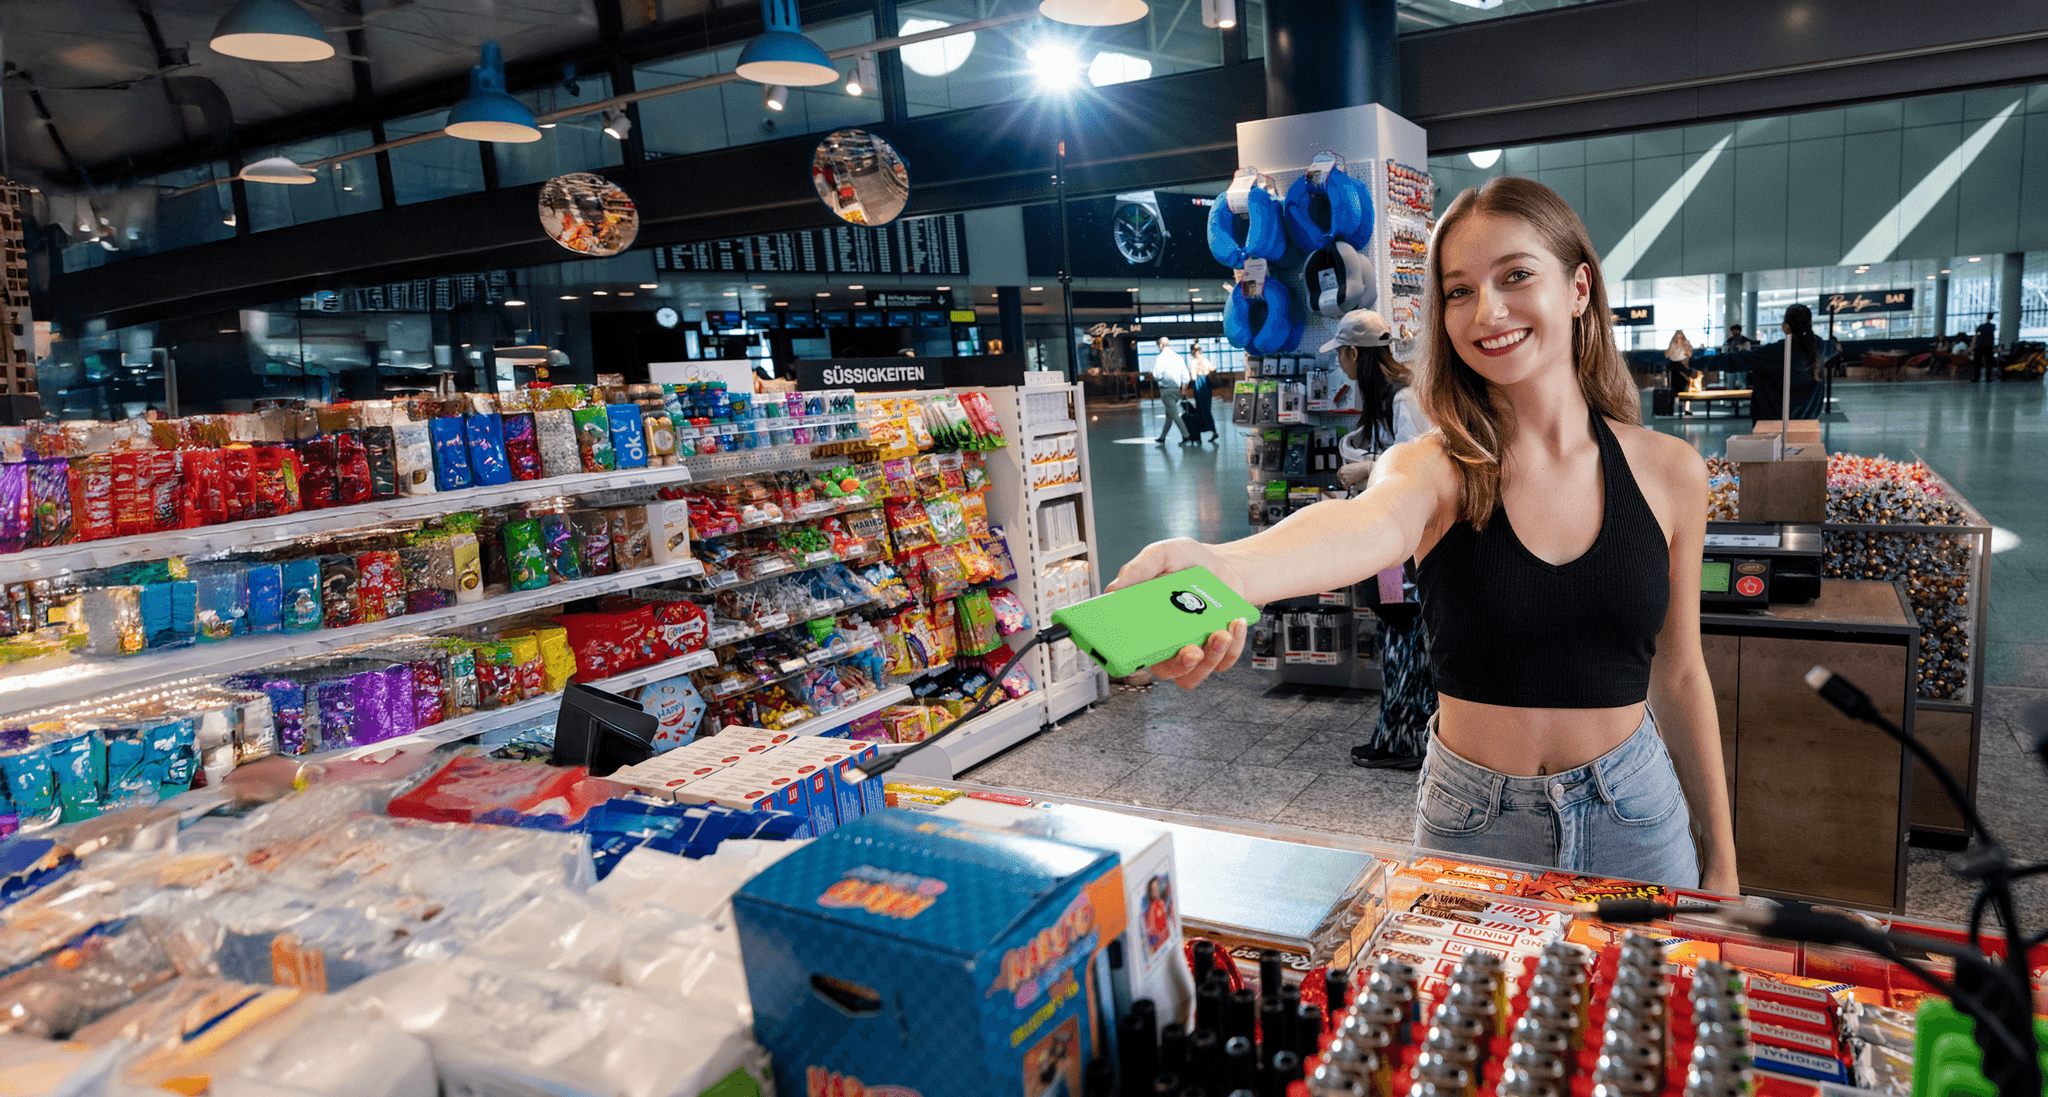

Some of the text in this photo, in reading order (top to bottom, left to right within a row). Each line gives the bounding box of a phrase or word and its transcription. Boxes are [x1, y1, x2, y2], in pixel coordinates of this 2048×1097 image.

[1885, 293, 1905, 304] BAR
[1630, 309, 1648, 319] BAR
[823, 366, 925, 386] SÜSSIGKEITEN
[853, 517, 884, 531] HARIBO
[814, 776, 824, 790] LU
[788, 787, 798, 802] LU
[1469, 867, 1497, 877] WHITE
[1450, 879, 1479, 888] WHITE
[1433, 892, 1463, 906] MAX
[1421, 907, 1454, 920] MAX
[1491, 904, 1555, 926] Kägi
[1463, 926, 1510, 941] MINOR
[1760, 981, 1822, 998] ORIGINAL
[1756, 1001, 1820, 1020] ORIGINAL
[1759, 1025, 1826, 1046] ORIGINAL
[1764, 1048, 1833, 1069] ORIGINAL
